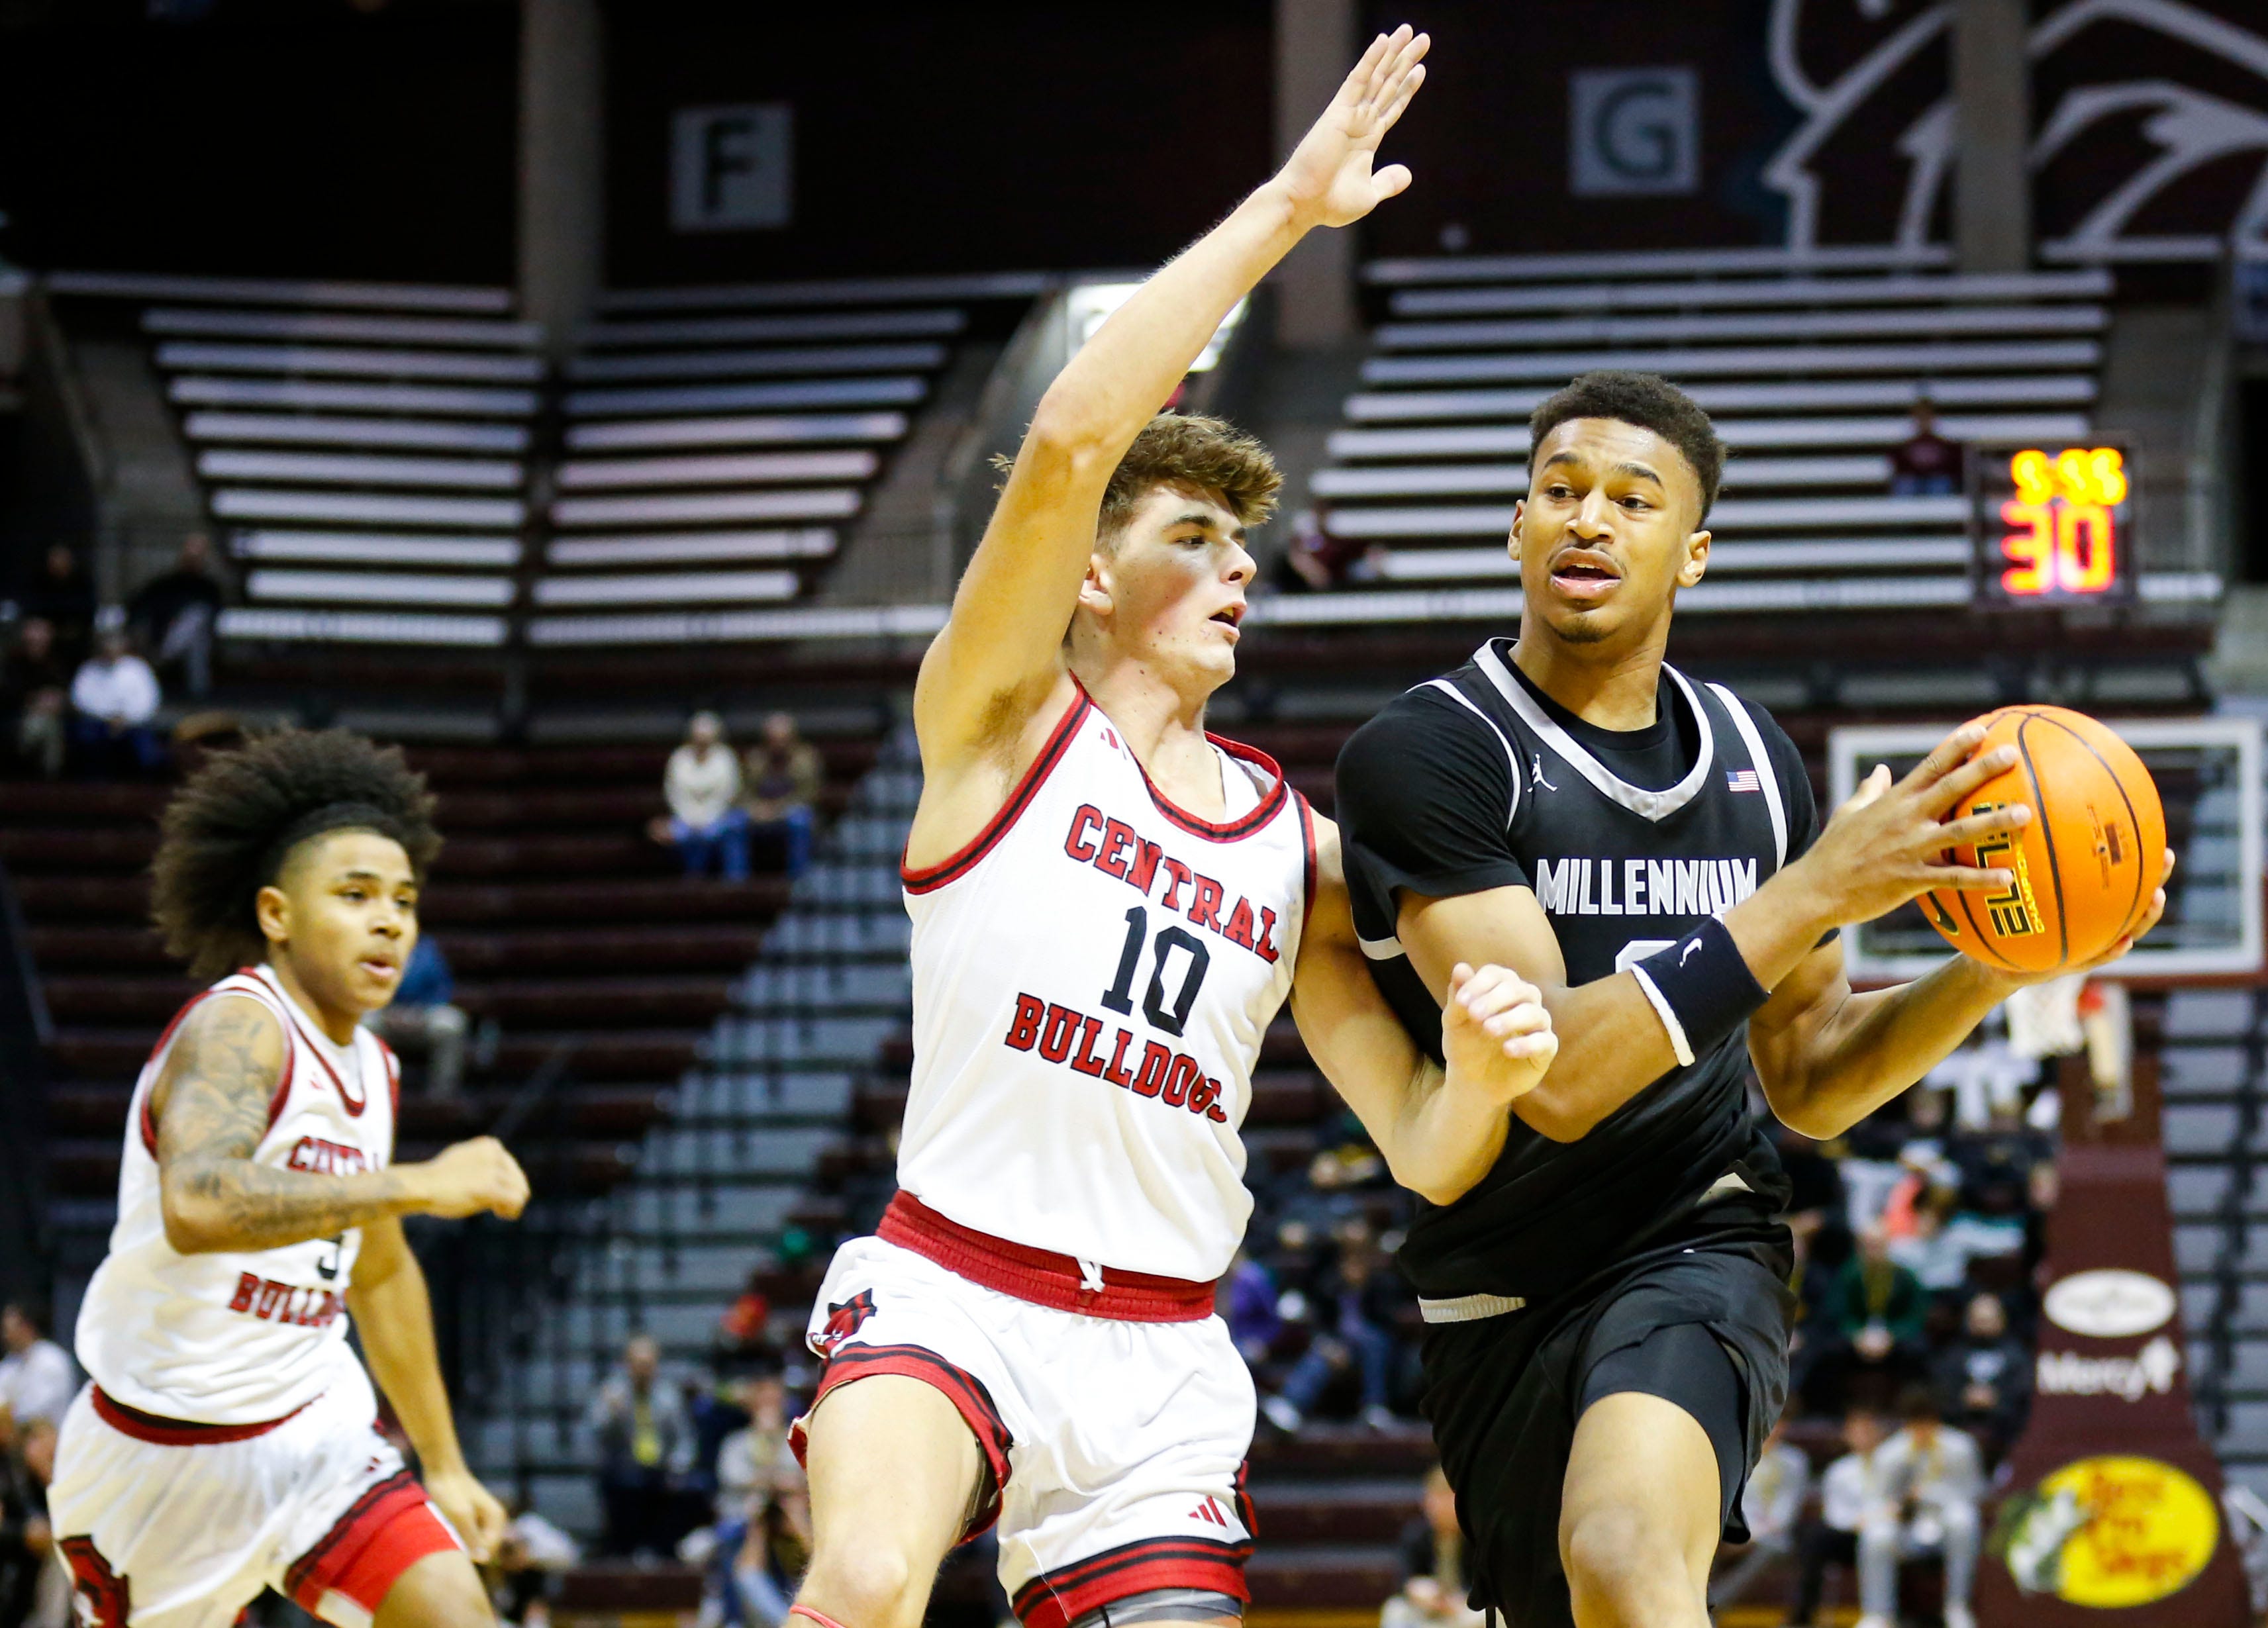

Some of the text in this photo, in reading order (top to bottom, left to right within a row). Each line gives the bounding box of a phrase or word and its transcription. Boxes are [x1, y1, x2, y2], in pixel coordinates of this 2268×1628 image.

[701, 117, 762, 214] F
[1592, 79, 1679, 179] G
[2000, 501, 2115, 594] 30
[1063, 802, 1279, 965] CENTRAL
[1536, 857, 1757, 915] MILLENNIUM
[1100, 906, 1210, 1037] 10
[1004, 992, 1227, 1123] BULLDOGS
